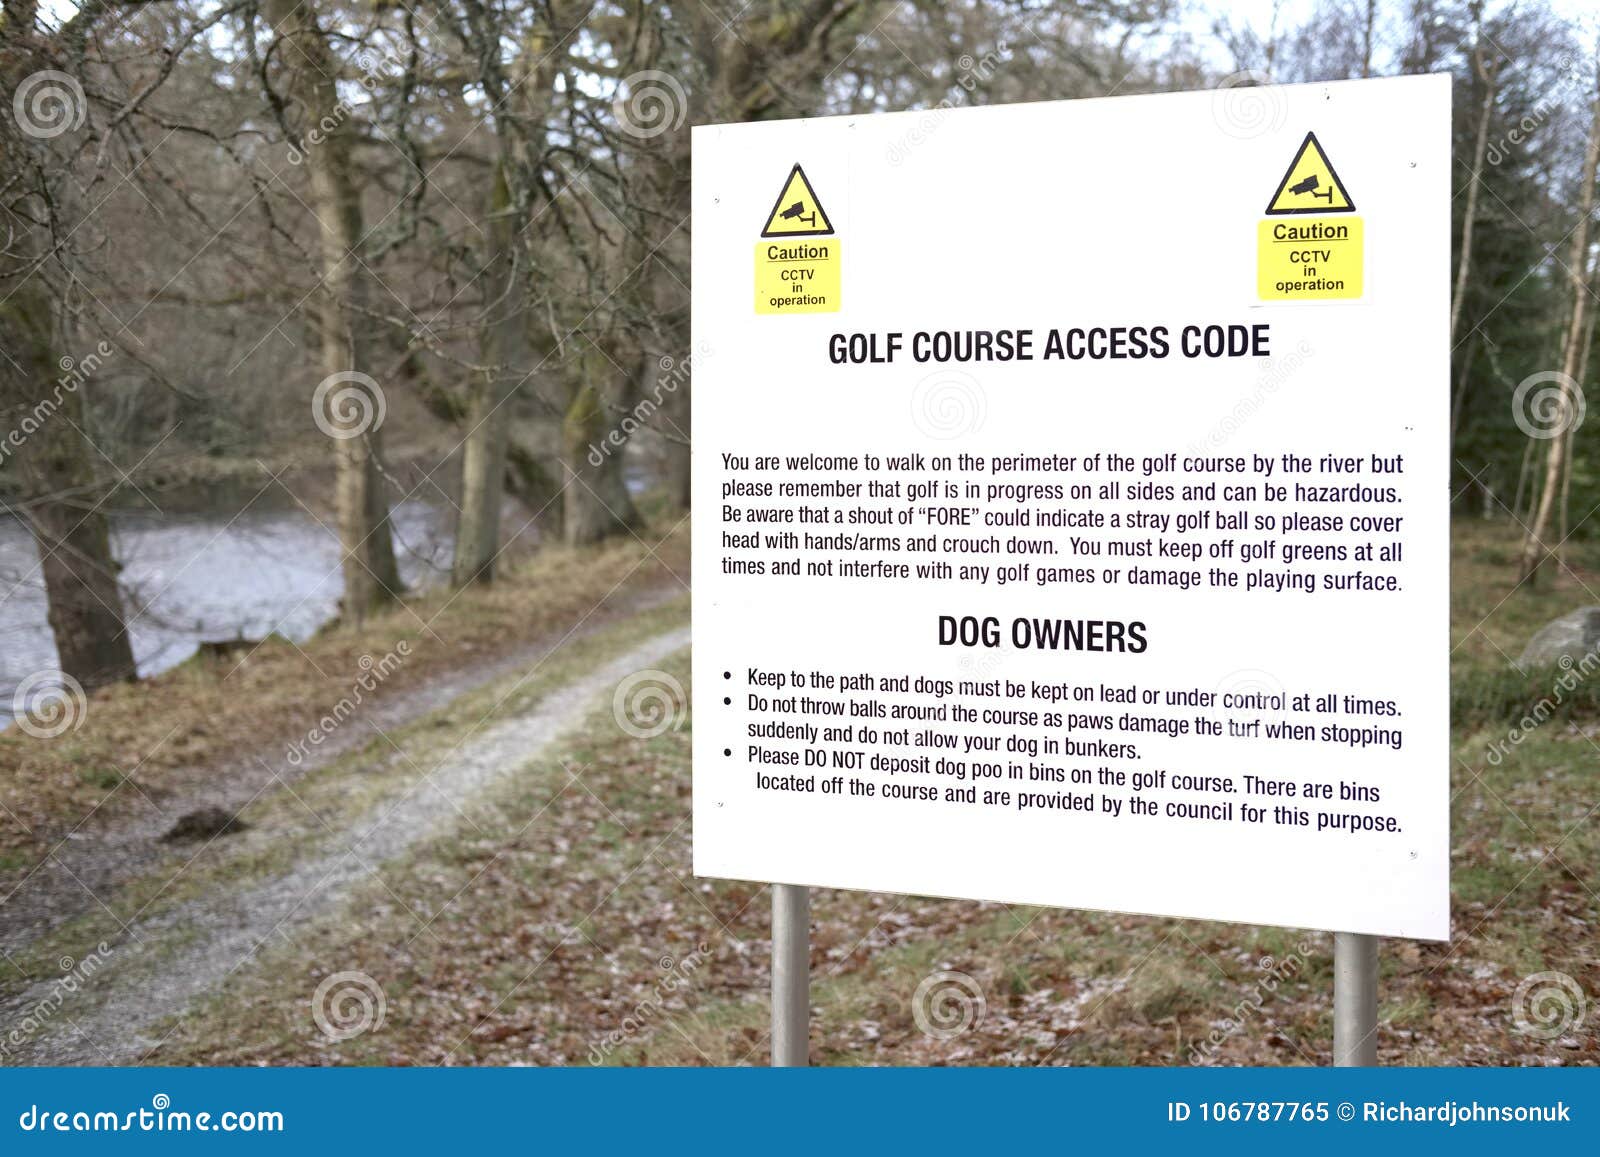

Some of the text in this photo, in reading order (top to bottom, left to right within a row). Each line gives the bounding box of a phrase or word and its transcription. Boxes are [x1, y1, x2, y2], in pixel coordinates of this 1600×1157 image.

[1273, 222, 1348, 240] Caution
[767, 245, 828, 260] Caution
[1289, 250, 1331, 264] CCTV
[780, 269, 815, 281] CCTV
[1303, 265, 1316, 277] in
[792, 282, 803, 293] in
[1275, 278, 1344, 294] operation
[769, 295, 826, 309] operation
[828, 323, 1271, 365] GOLF COURSE ACCESS CODE
[721, 452, 1404, 478] You are welcome to walk on the perimeter of the golf course by the river but
[722, 478, 1402, 504] please remember that golf is in progress on all sides and can be hazardous.
[722, 504, 742, 523] Be
[746, 508, 794, 524] aware
[798, 505, 830, 524] that
[834, 509, 844, 524] a
[848, 506, 894, 525] shout
[897, 506, 915, 525] of
[984, 507, 1030, 527] could
[1036, 508, 1105, 528] indicate
[1110, 513, 1121, 528] a
[1126, 509, 1171, 534] stray
[1176, 510, 1211, 534] golf
[1215, 510, 1248, 530] ball
[1254, 515, 1276, 531] so
[1282, 511, 1344, 535] please
[1349, 516, 1404, 533] cover
[722, 530, 1402, 565] head with hands/arms and crouch down. You must keep off golf greens at all
[721, 556, 1402, 594] times and not interfere with any golf games or damage the playing surface.
[938, 615, 1148, 654] DOG OWNERS
[748, 667, 1402, 717] Keep to the path and dogs must be kept on lead or under at all times.
[748, 693, 1402, 750] Do not throw balls around the course as paws damage the when stopping
[748, 745, 1380, 803] Please DO NOT deposit dog poo in bins on the golf course. There are bins
[756, 771, 1402, 834] located off the course and are provided by the council for this purpose.
